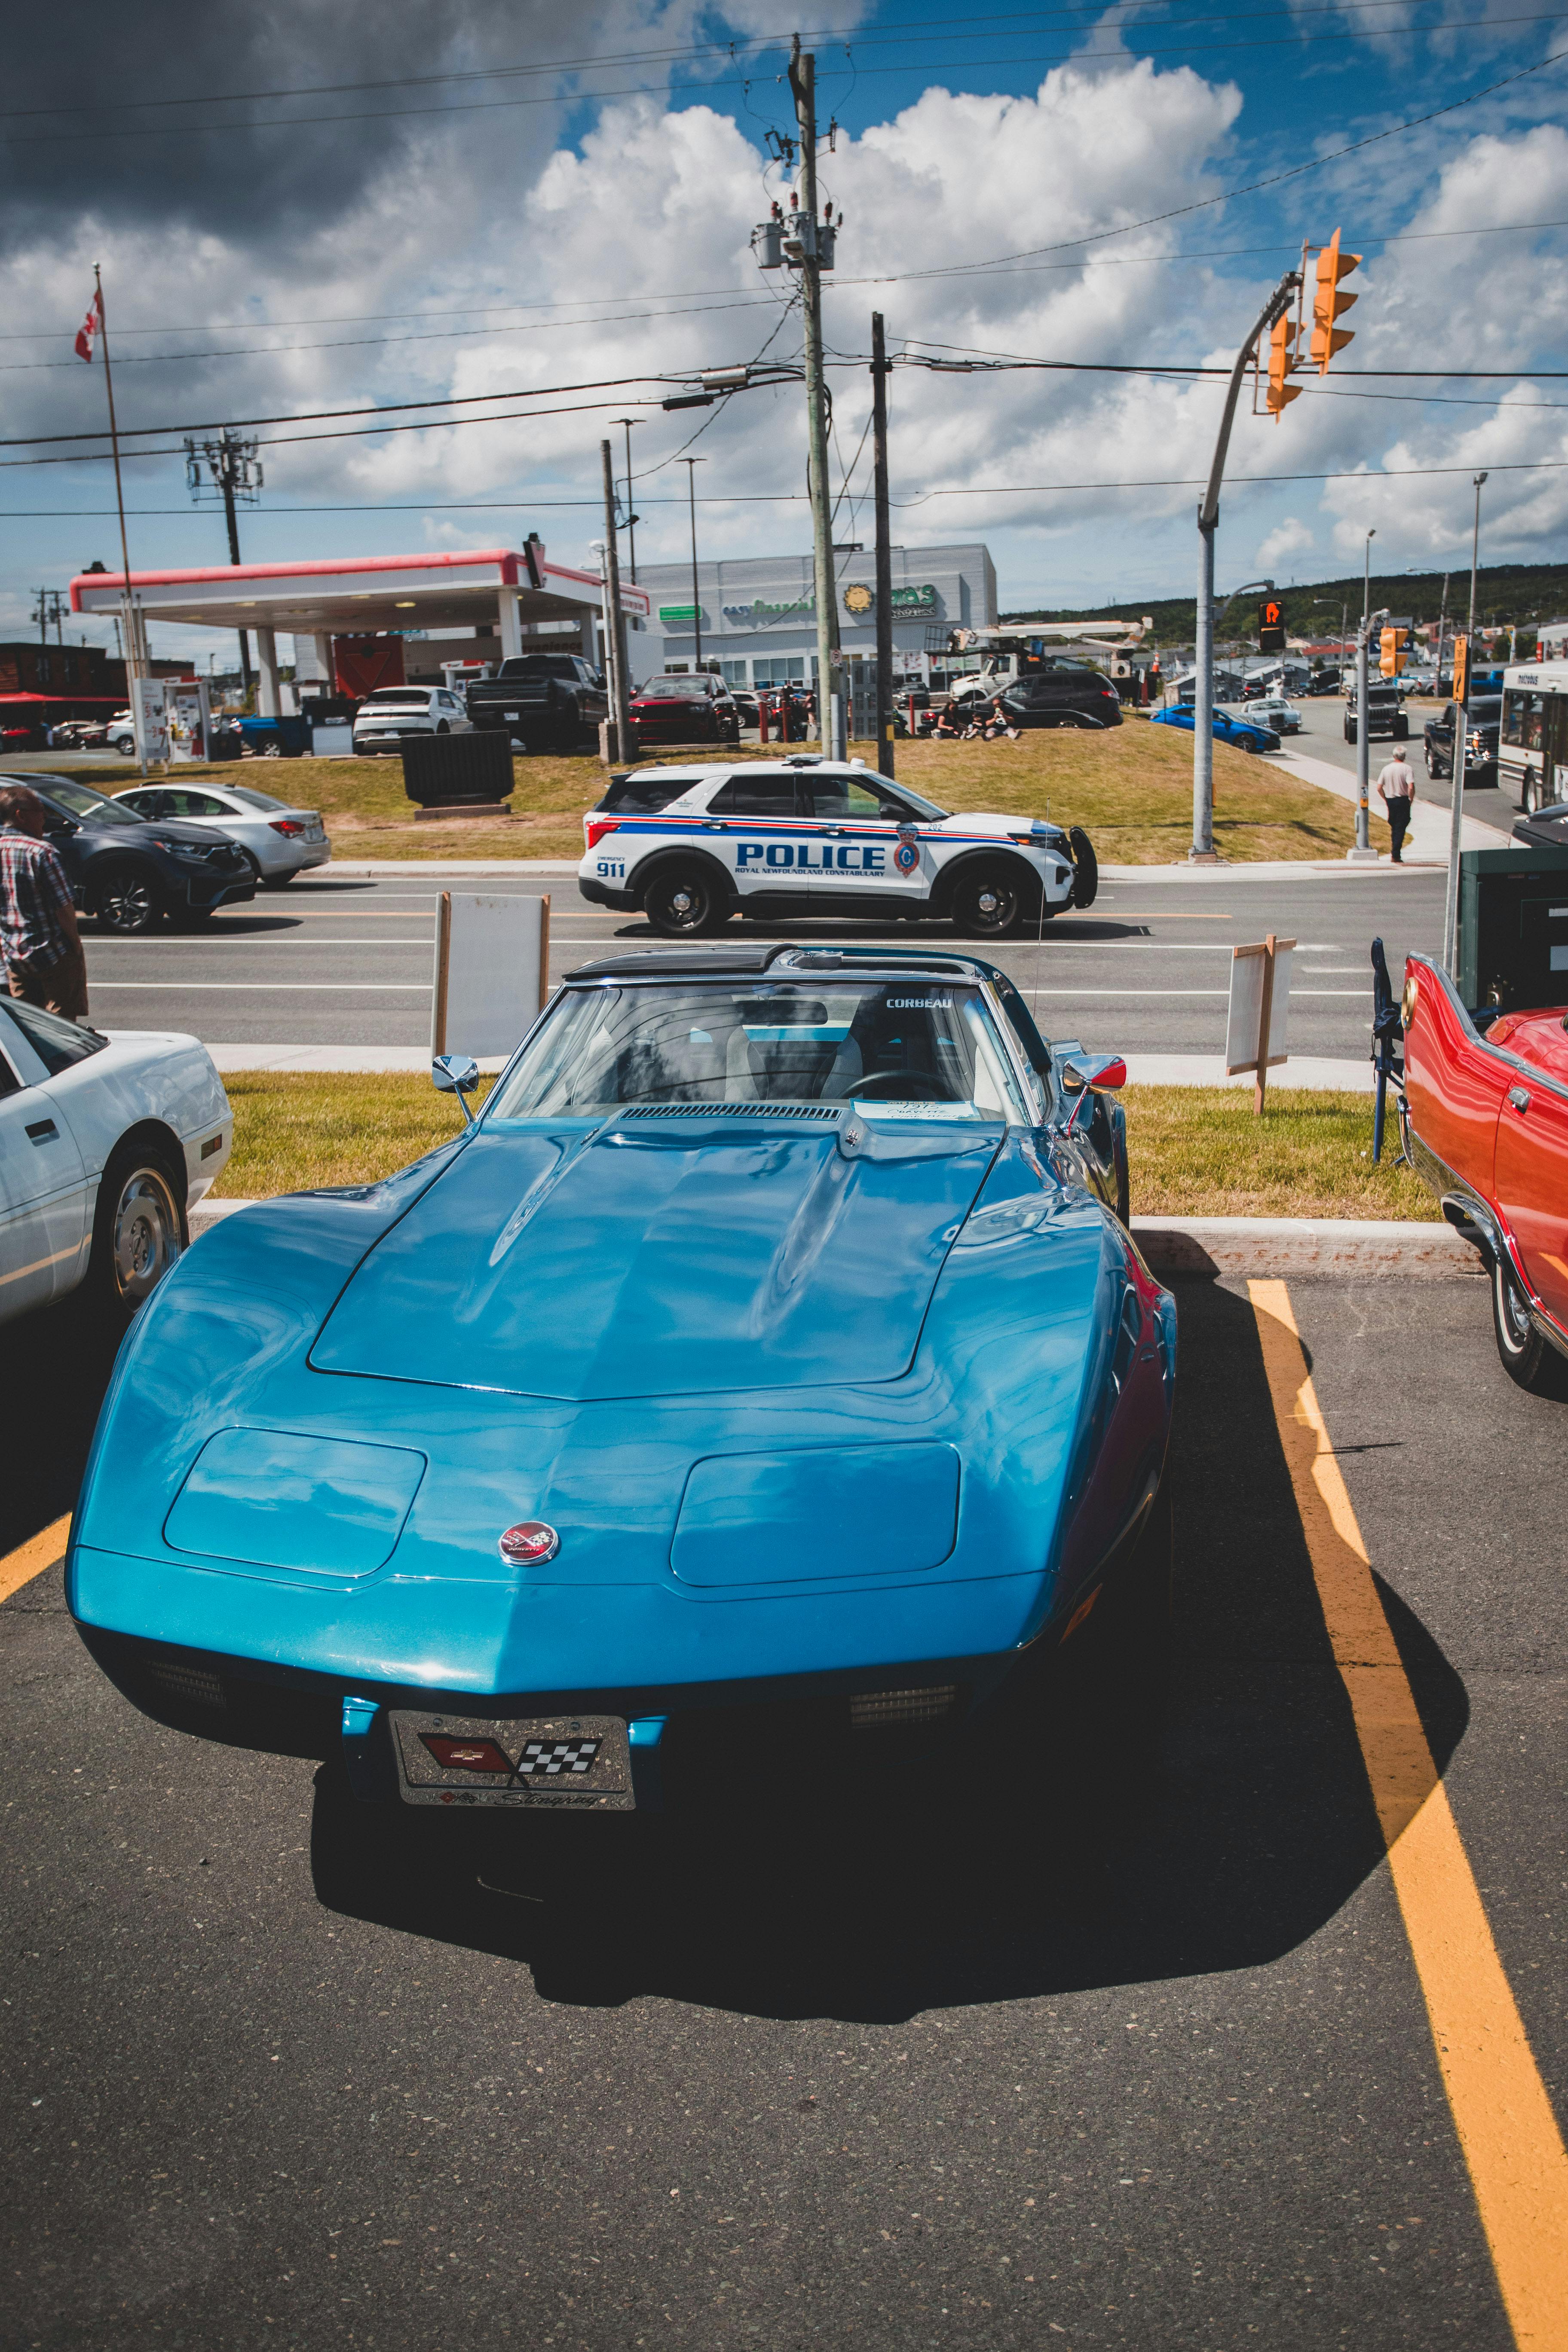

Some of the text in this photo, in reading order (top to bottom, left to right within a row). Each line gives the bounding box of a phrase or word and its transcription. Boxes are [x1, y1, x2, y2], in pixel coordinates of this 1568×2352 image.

[737, 843, 886, 870] POLICE
[597, 863, 625, 877] 911
[886, 998, 952, 1008] CORBEAU
[493, 1792, 602, 1807] Stingray
